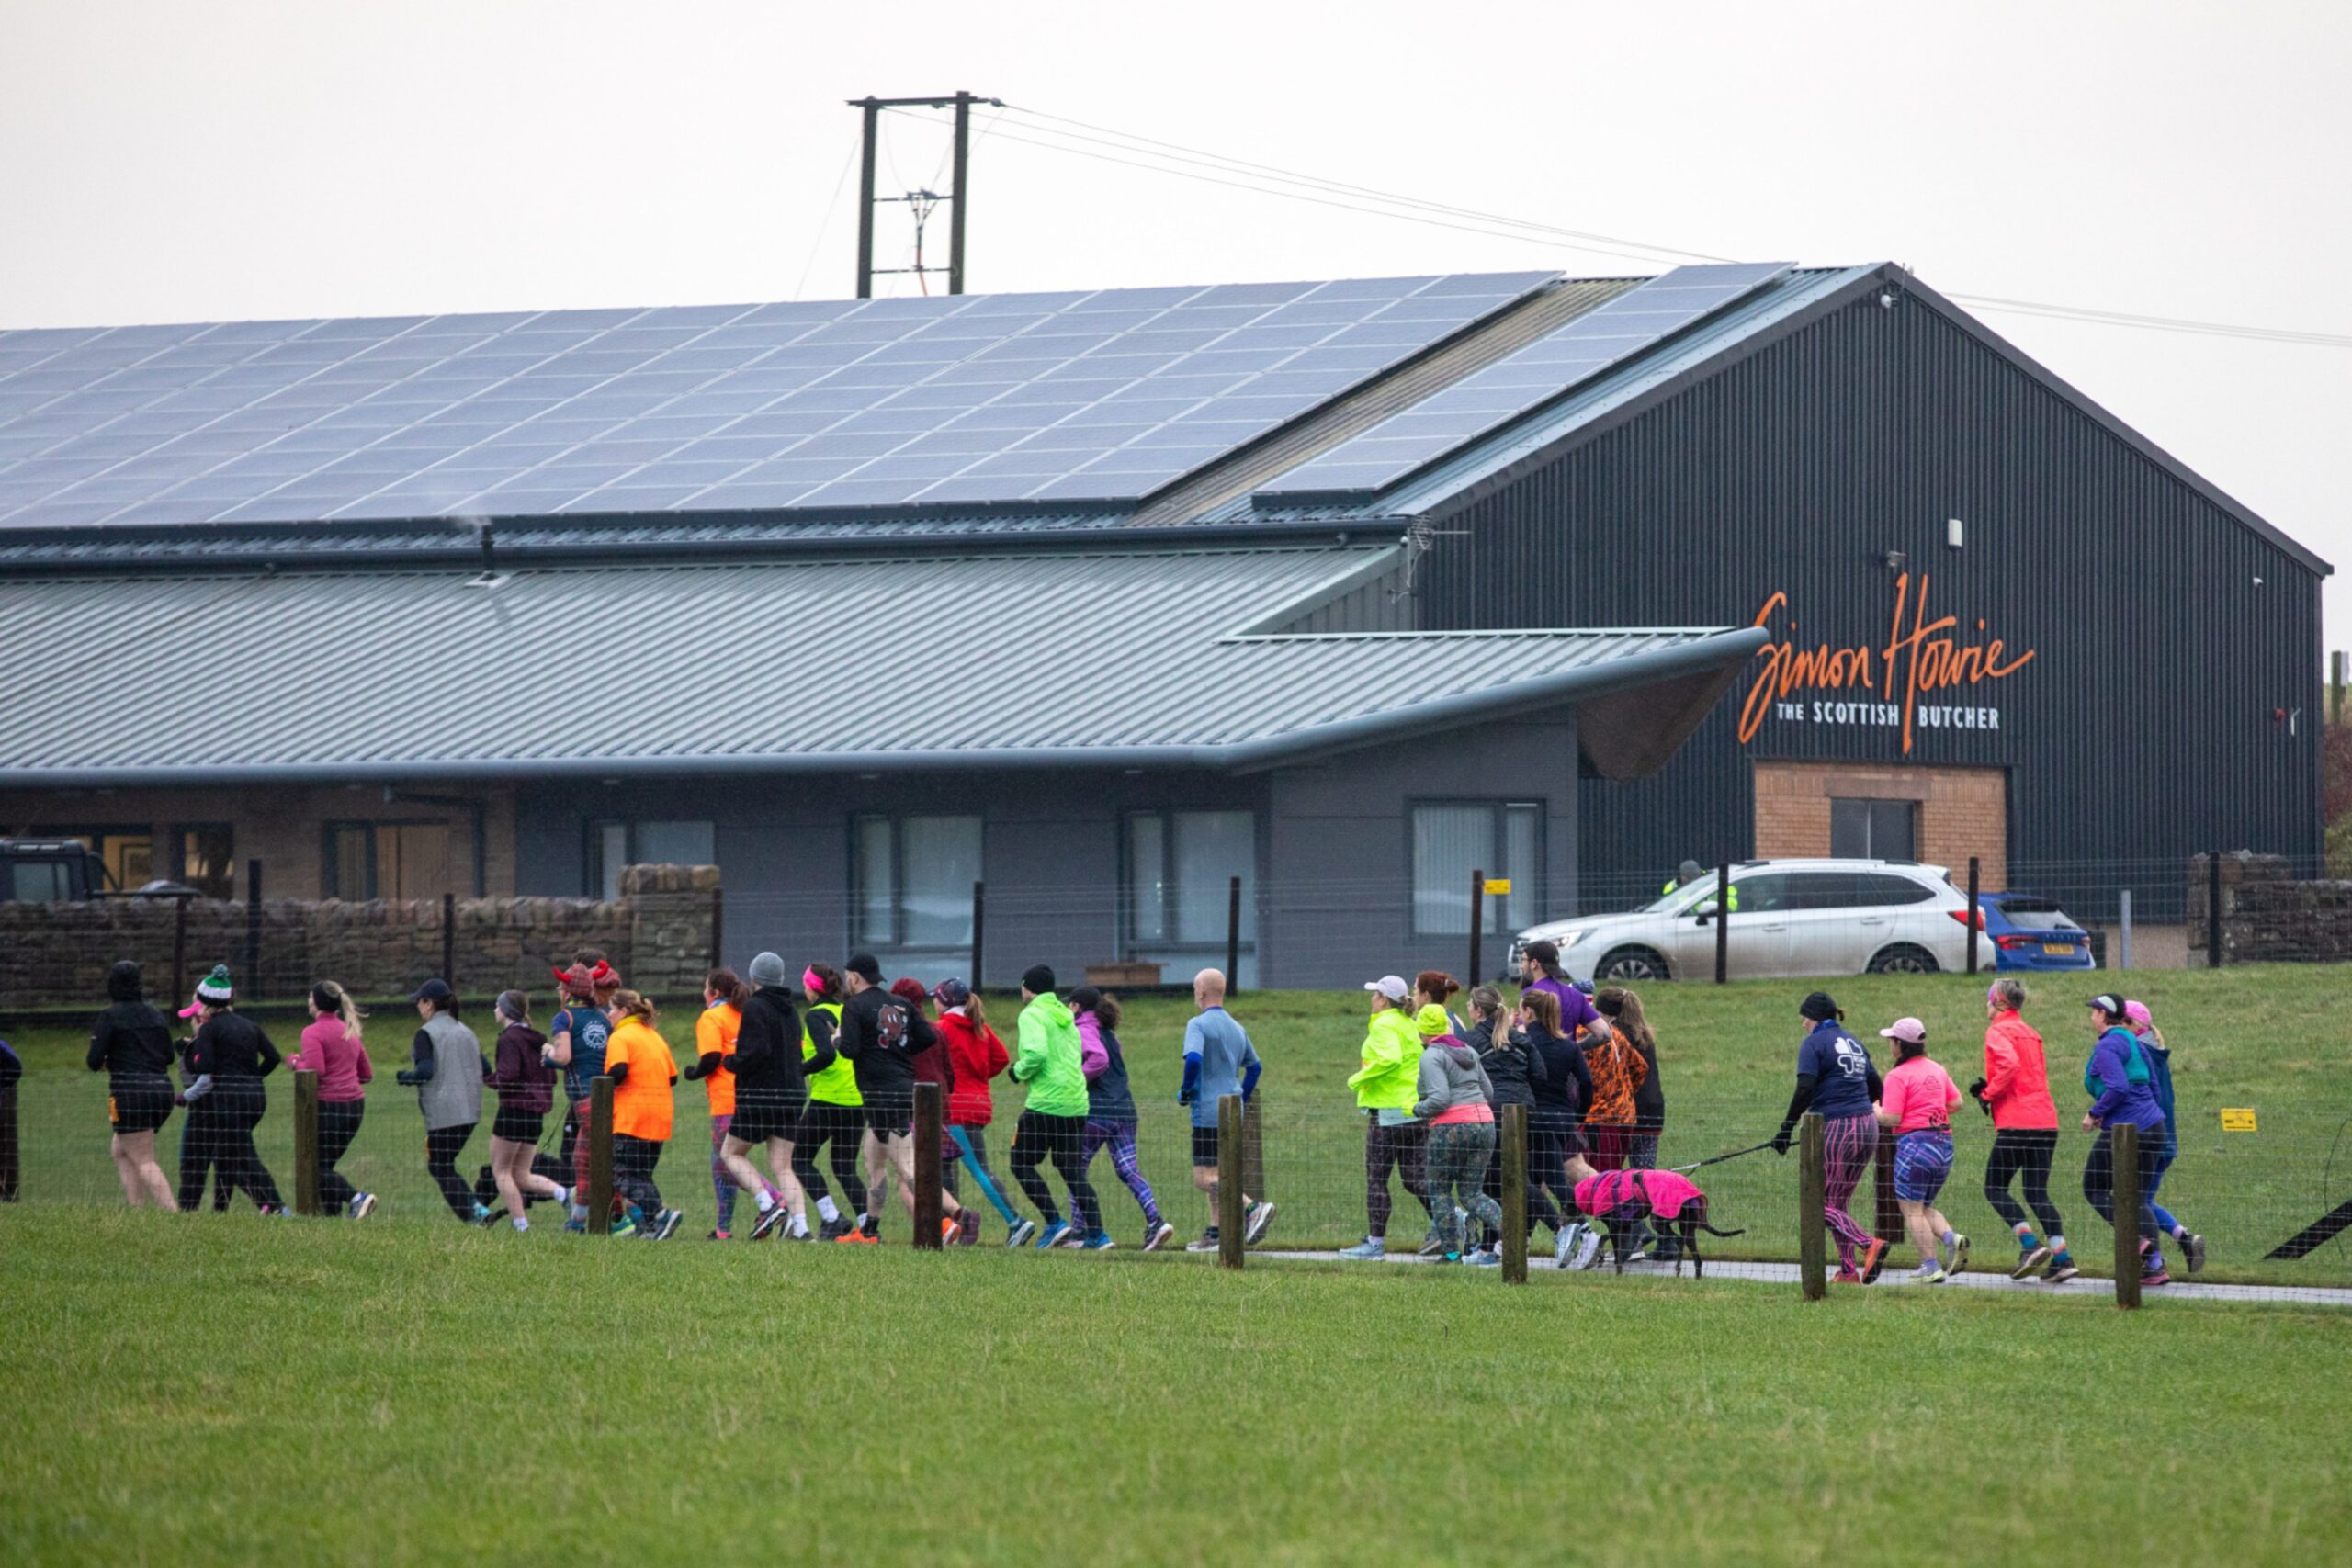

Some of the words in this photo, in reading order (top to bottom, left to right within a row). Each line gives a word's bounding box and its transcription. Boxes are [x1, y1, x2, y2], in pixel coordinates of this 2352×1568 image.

[1739, 592, 1873, 744] Simon
[1883, 572, 2035, 754] Howie
[1777, 703, 1804, 721] THE
[1813, 701, 1899, 727] SCOTTISH
[1918, 705, 2000, 729] BUTCHER
